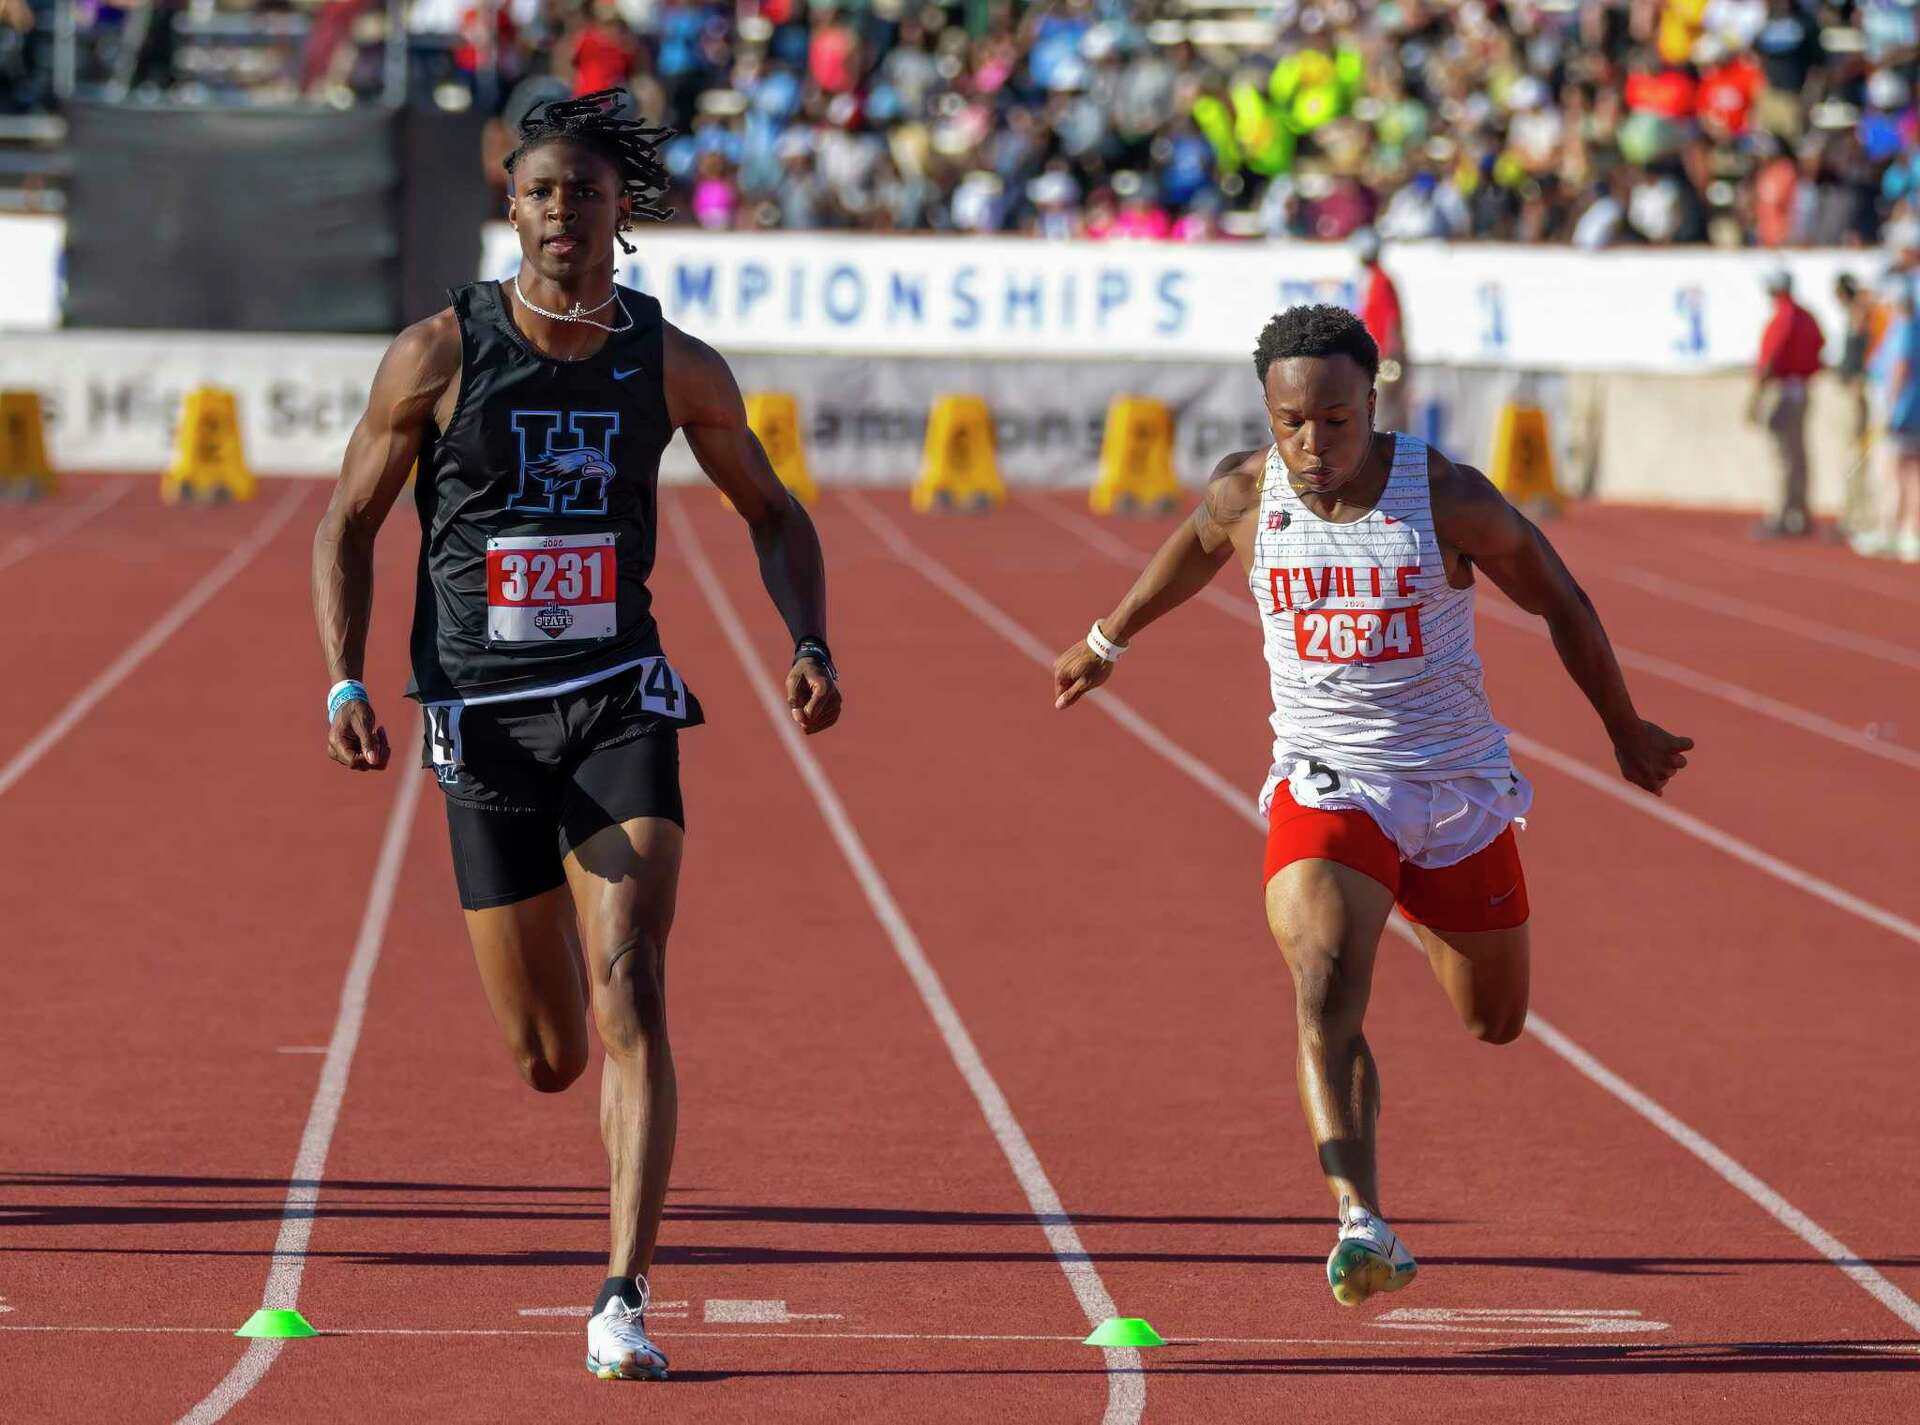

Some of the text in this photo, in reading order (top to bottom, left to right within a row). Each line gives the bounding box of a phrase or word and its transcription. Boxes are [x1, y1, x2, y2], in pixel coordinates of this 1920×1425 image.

[504, 256, 1188, 334] MPIONSHIPS
[501, 552, 602, 601] 3231
[535, 615, 573, 627] STATE
[1303, 612, 1411, 658] 2634
[644, 658, 679, 711] 4
[435, 705, 454, 761] 4
